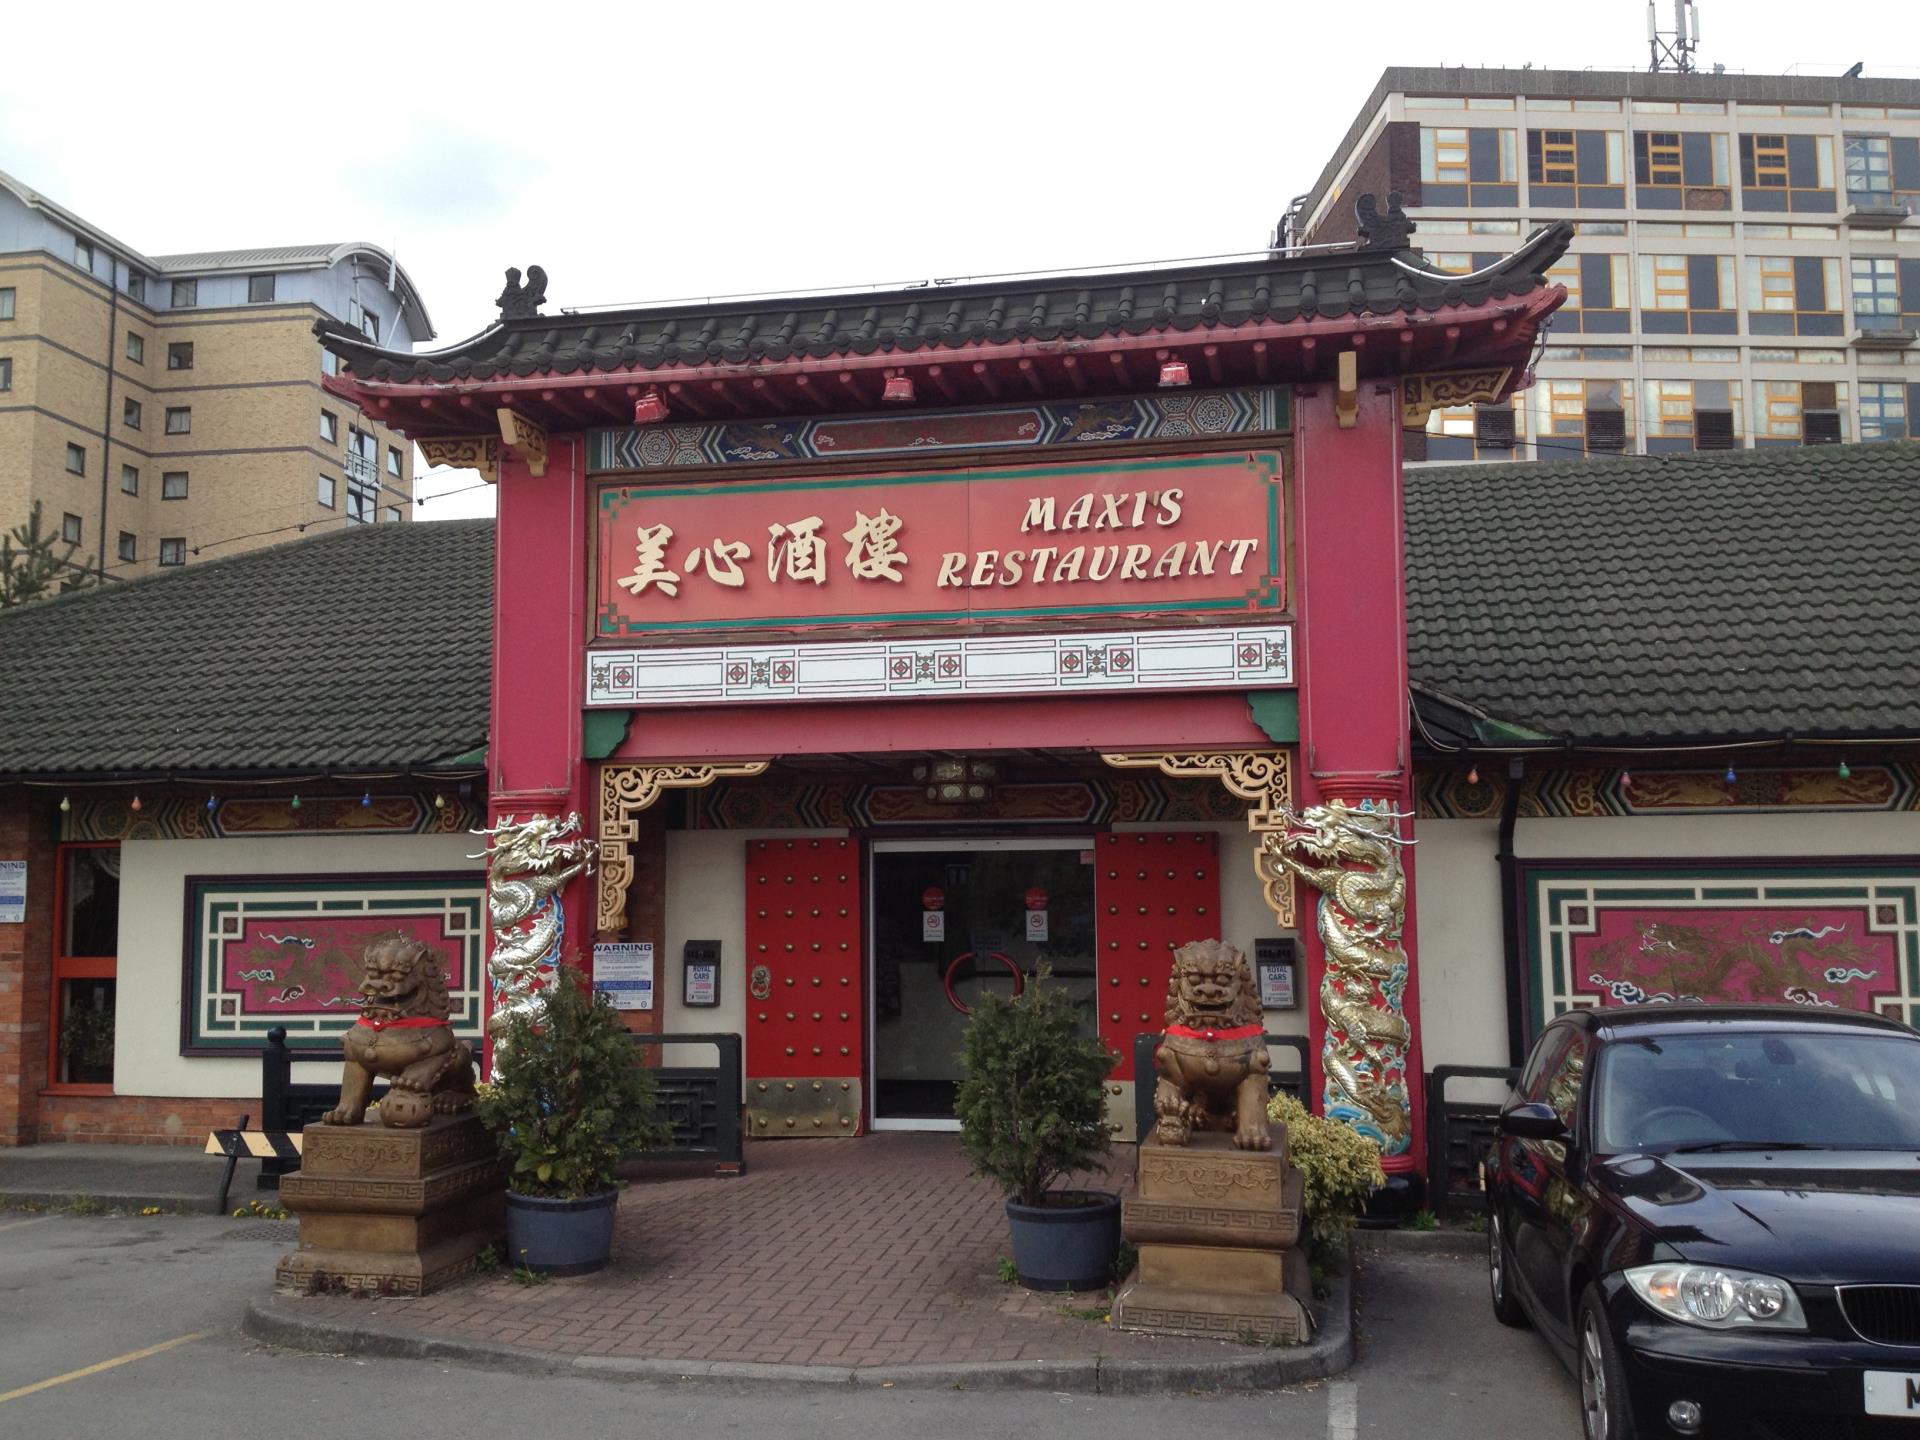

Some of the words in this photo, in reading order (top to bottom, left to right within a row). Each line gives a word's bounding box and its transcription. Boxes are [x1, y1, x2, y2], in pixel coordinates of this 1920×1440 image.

[1020, 488, 1184, 533] MAXI'S
[618, 508, 908, 597] 美心酒樓
[937, 539, 1259, 589] RESTAURANT
